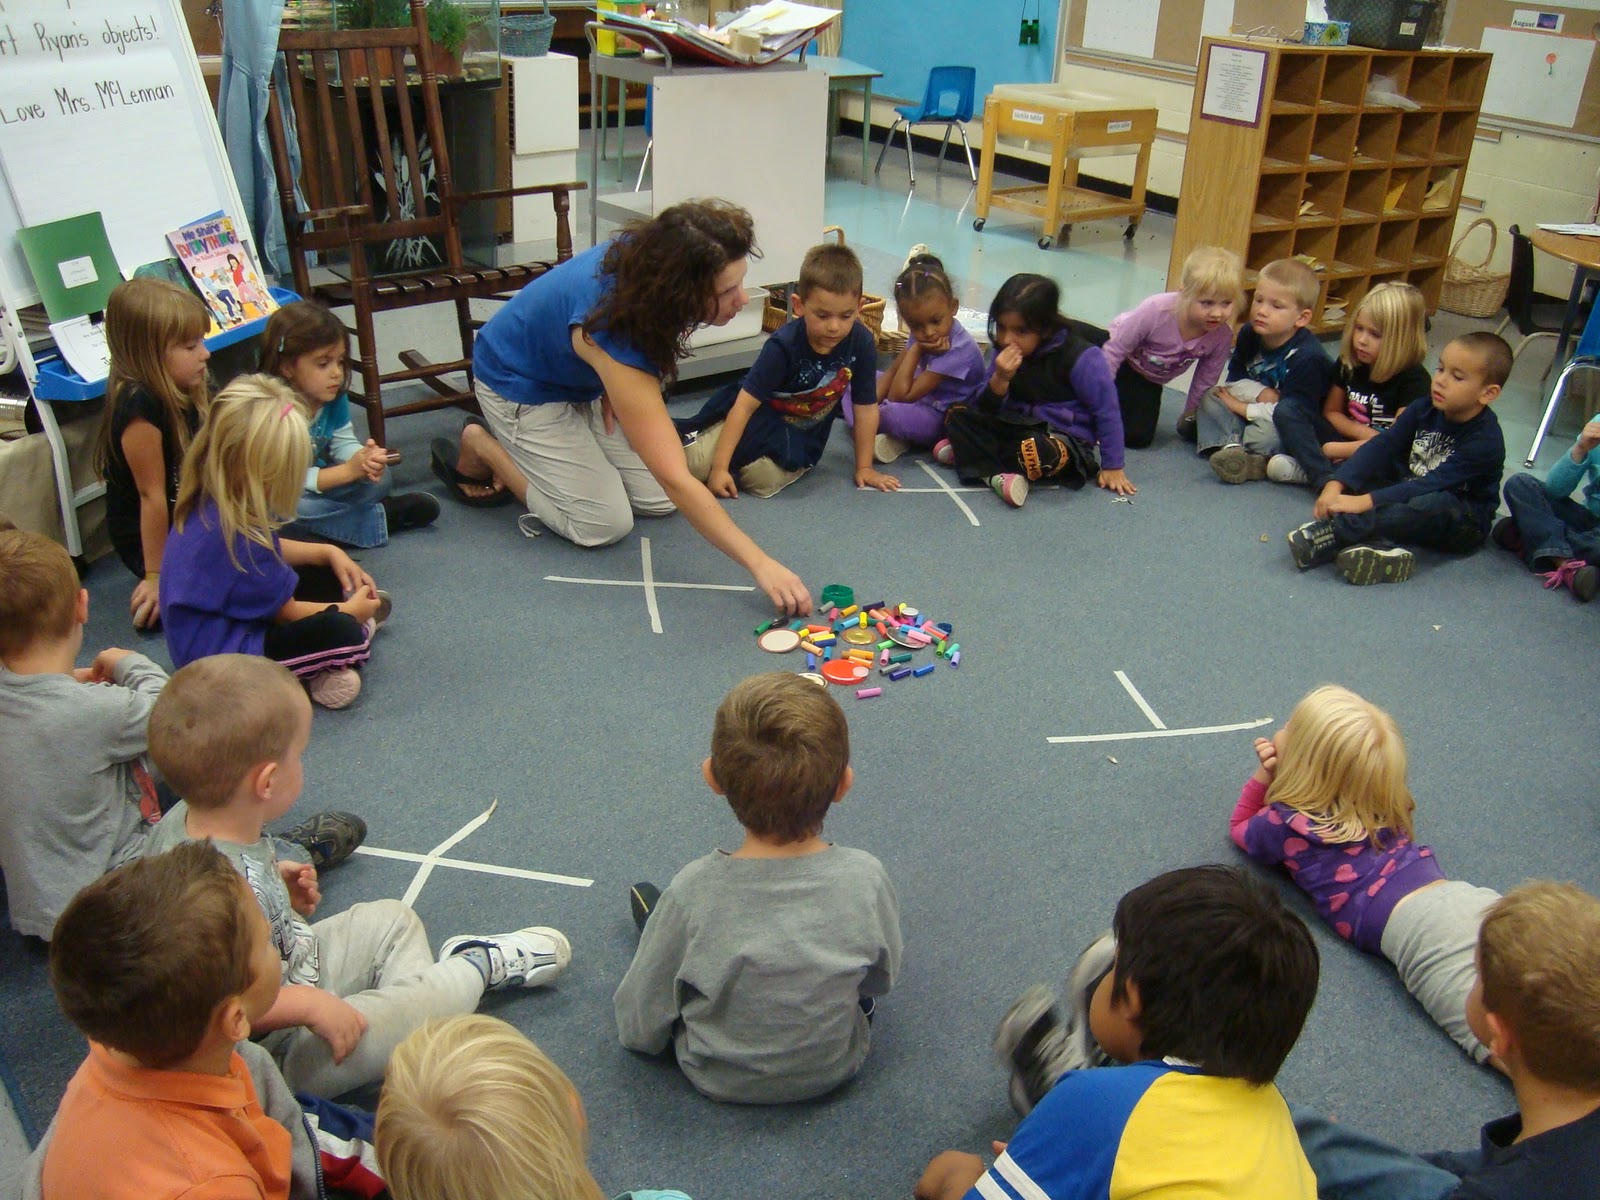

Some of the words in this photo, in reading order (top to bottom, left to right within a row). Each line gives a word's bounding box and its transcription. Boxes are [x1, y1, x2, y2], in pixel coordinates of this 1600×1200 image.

[1513, 20, 1535, 28] August
[33, 22, 89, 62] Ryan's
[102, 14, 160, 55] objects!
[0, 103, 45, 124] Love
[54, 87, 96, 115] Mrs.
[95, 80, 175, 109] McLennan
[182, 230, 196, 241] We
